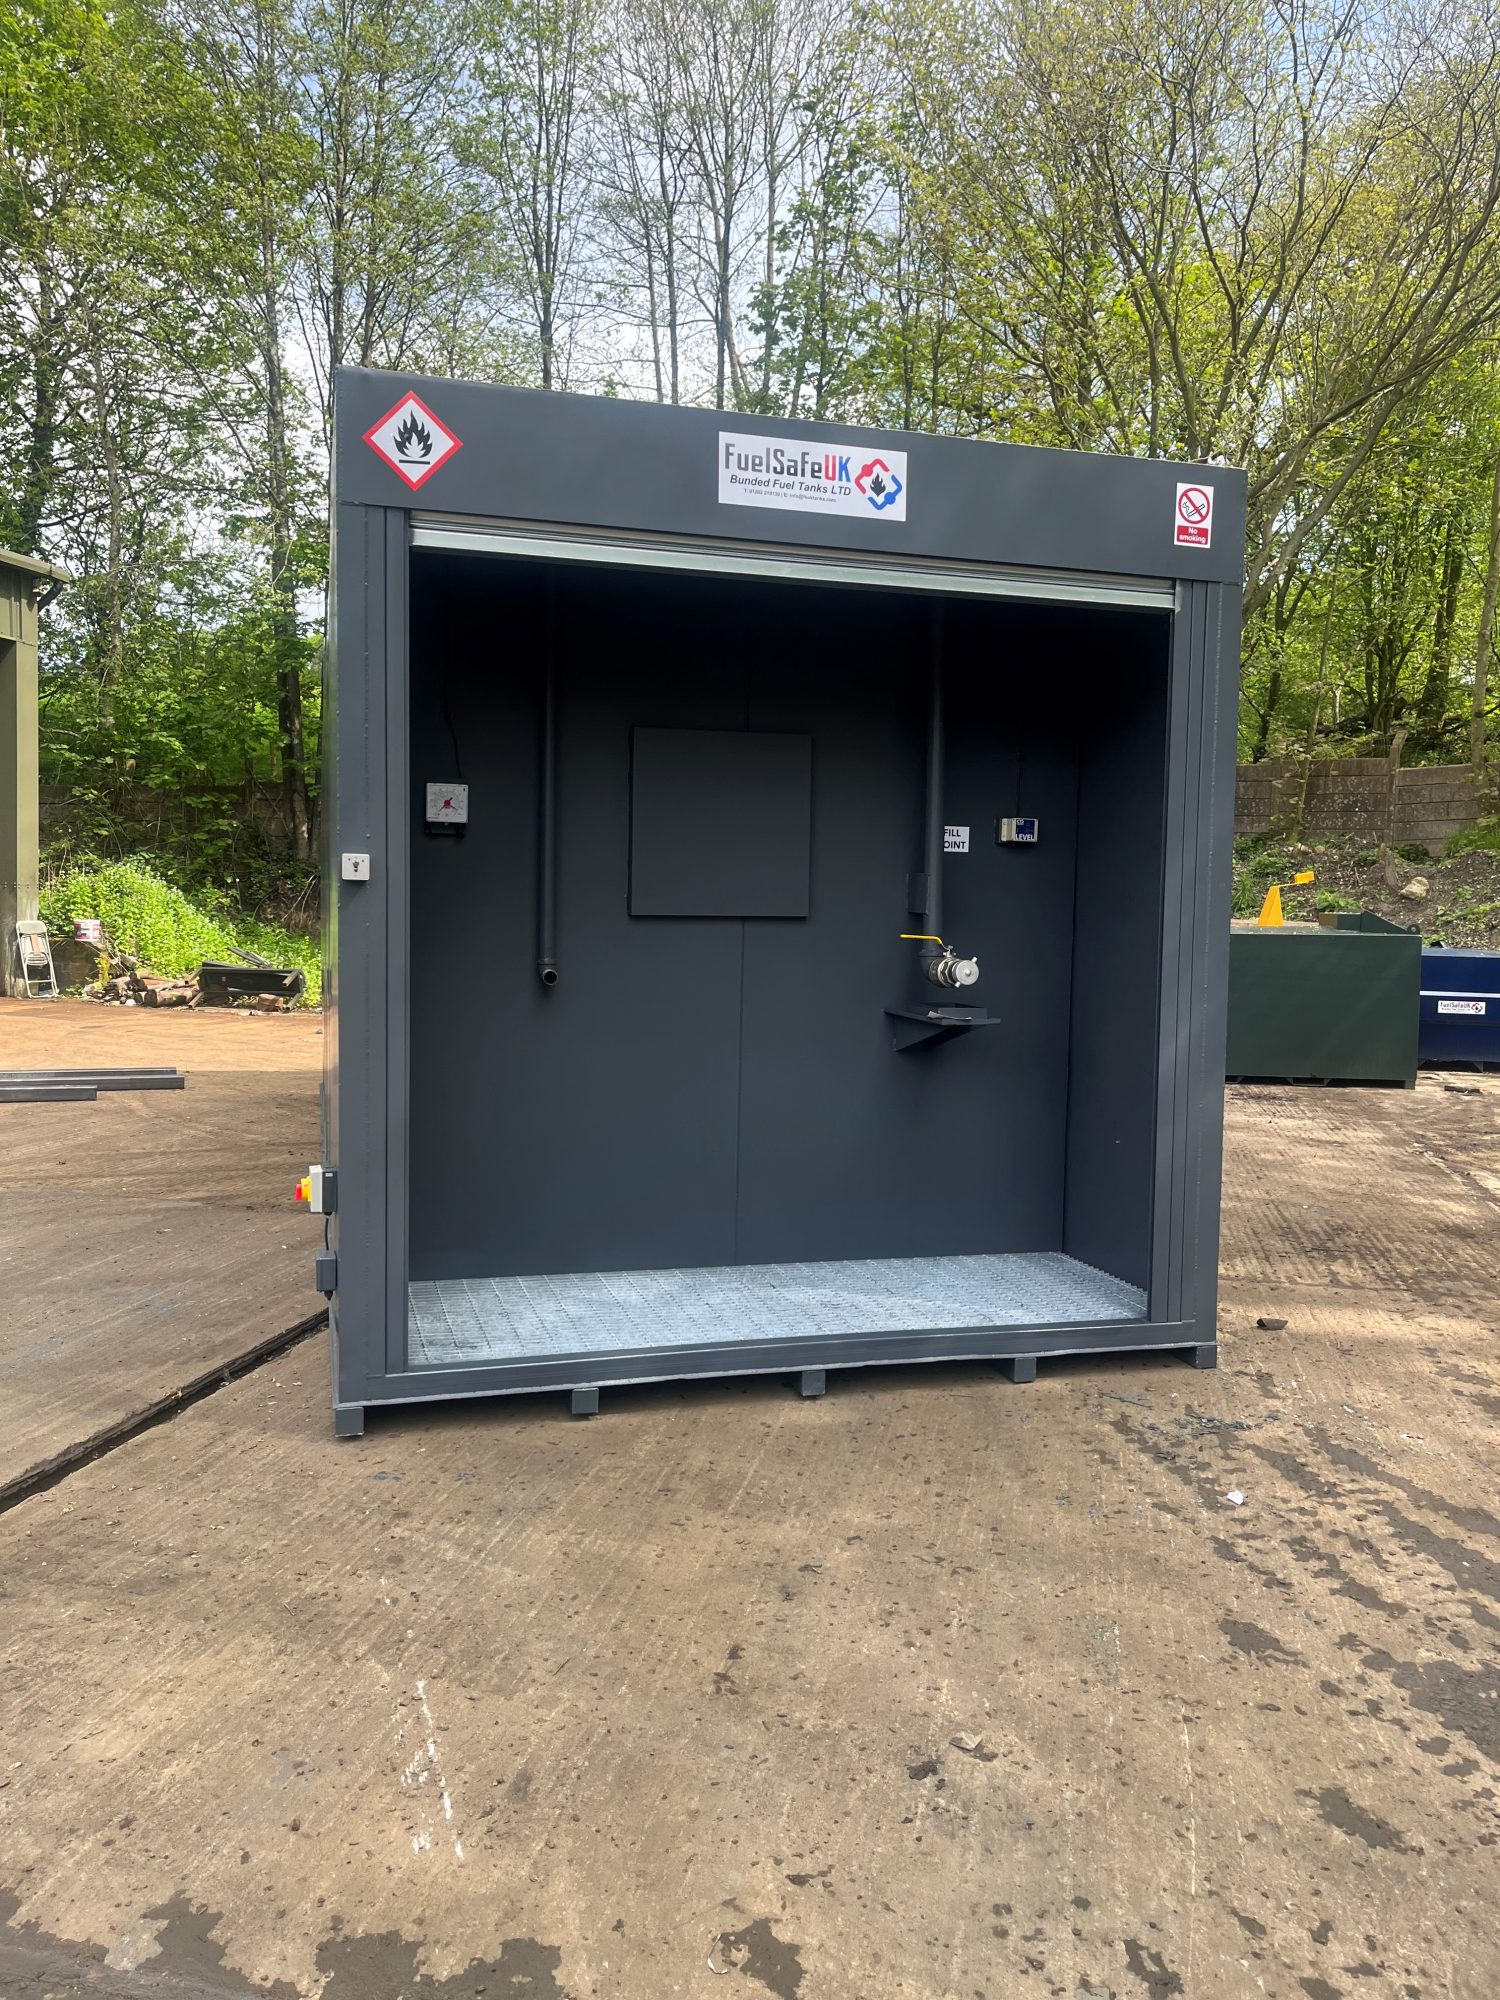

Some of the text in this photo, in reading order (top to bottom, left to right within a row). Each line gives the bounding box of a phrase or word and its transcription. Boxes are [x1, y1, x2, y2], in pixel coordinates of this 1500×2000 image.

[725, 442, 851, 483] FuelSafeUK
[730, 474, 852, 496] Bunded Fuel Tanks LTD
[1188, 527, 1198, 535] No
[1179, 534, 1206, 544] smoking
[1015, 833, 1035, 841] LEVEL
[943, 840, 966, 849] OINT
